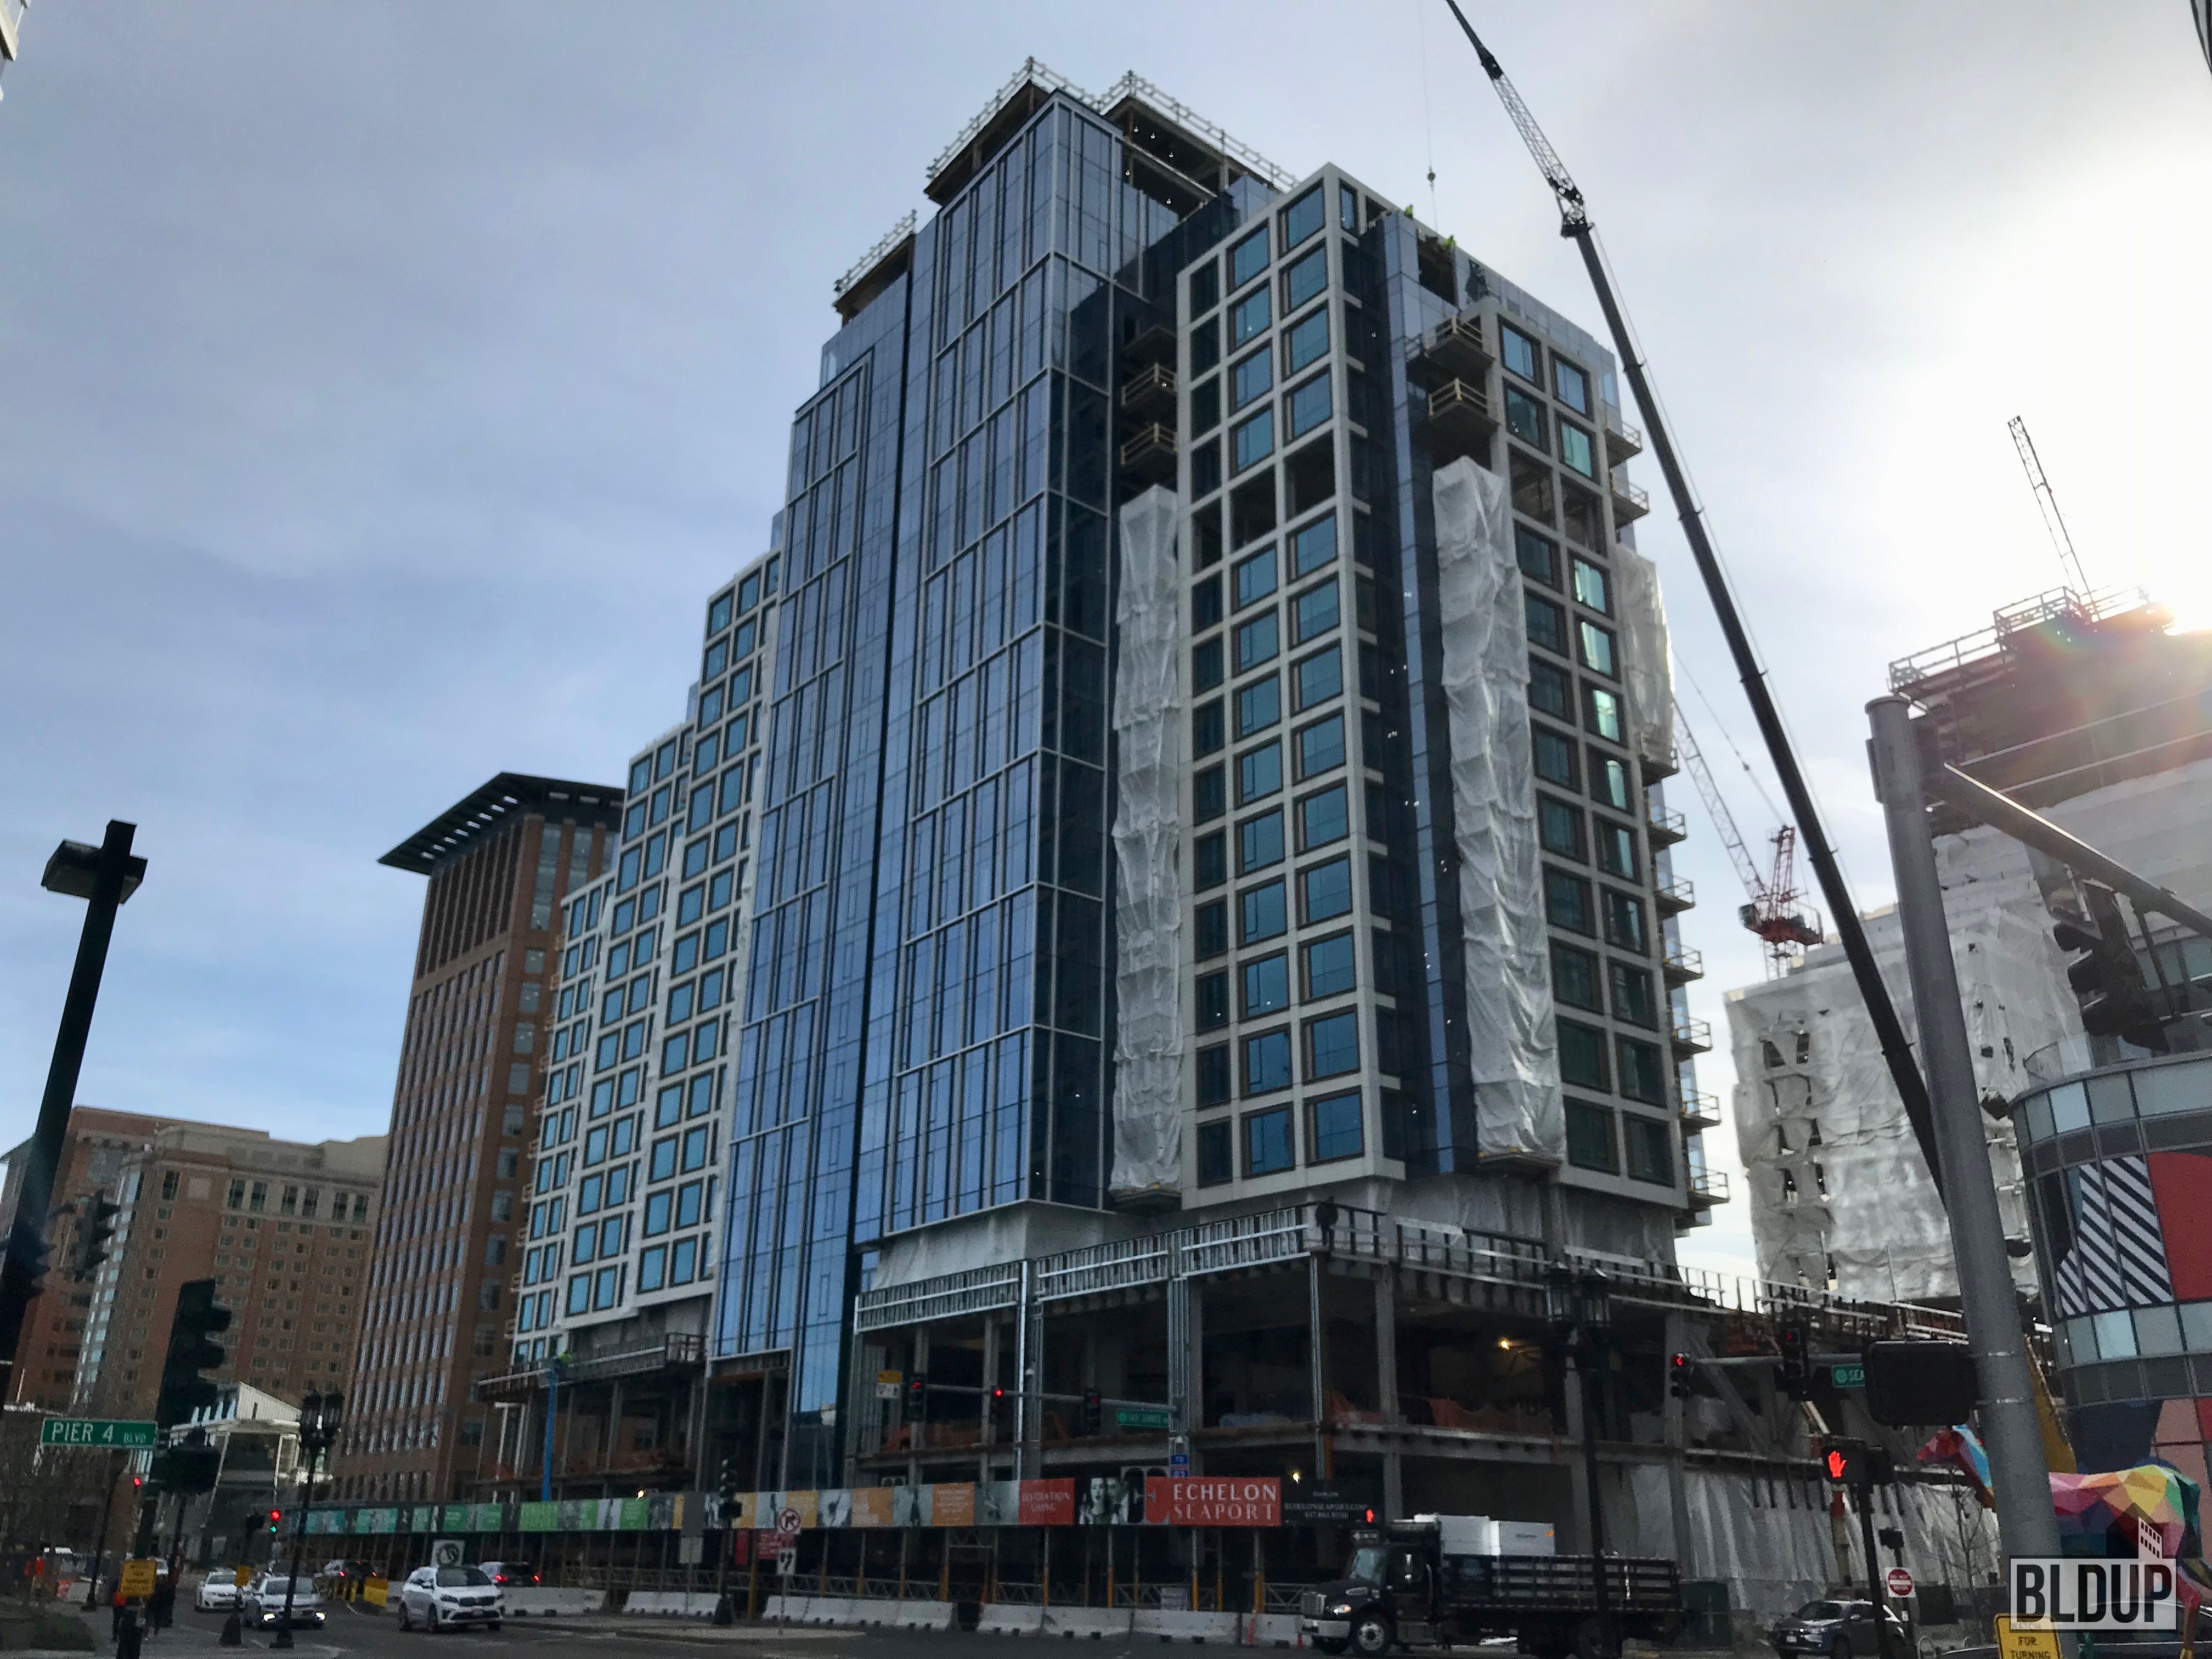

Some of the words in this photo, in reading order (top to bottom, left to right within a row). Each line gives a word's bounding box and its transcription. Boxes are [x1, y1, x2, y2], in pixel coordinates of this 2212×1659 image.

[52, 1421, 93, 1442] PIER
[102, 1424, 114, 1443] 4
[123, 1432, 146, 1444] BLVD
[1173, 1483, 1277, 1502] ECHELON
[1173, 1503, 1275, 1520] SEAPORT
[2018, 1636, 2037, 1646] FOR
